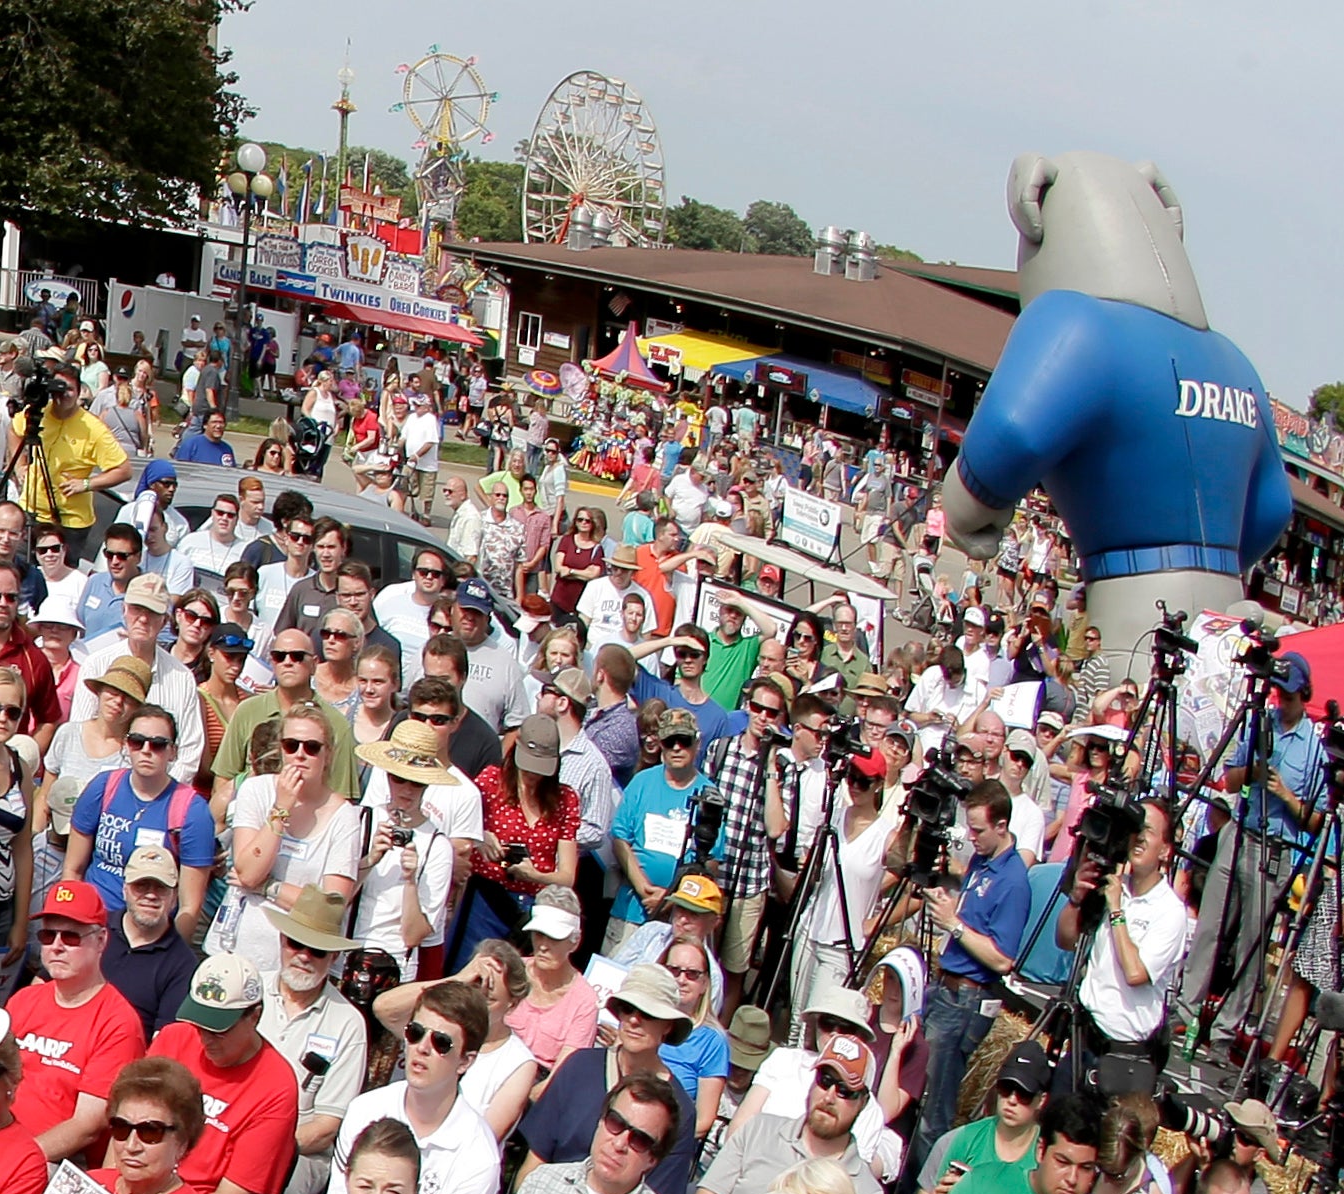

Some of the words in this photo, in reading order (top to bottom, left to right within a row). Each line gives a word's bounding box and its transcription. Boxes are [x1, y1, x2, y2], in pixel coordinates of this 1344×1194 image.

[307, 262, 338, 279] COOKIES
[312, 255, 333, 266] OREO
[219, 264, 244, 285] CAND
[249, 270, 272, 287] BARS
[285, 277, 315, 290] PEPSI
[321, 282, 381, 308] TWINKIES
[389, 295, 412, 312] OREO
[412, 298, 447, 322] COOKIES
[1174, 379, 1257, 429] DRAKE
[98, 823, 121, 840] OUT
[15, 1032, 73, 1059] AARP
